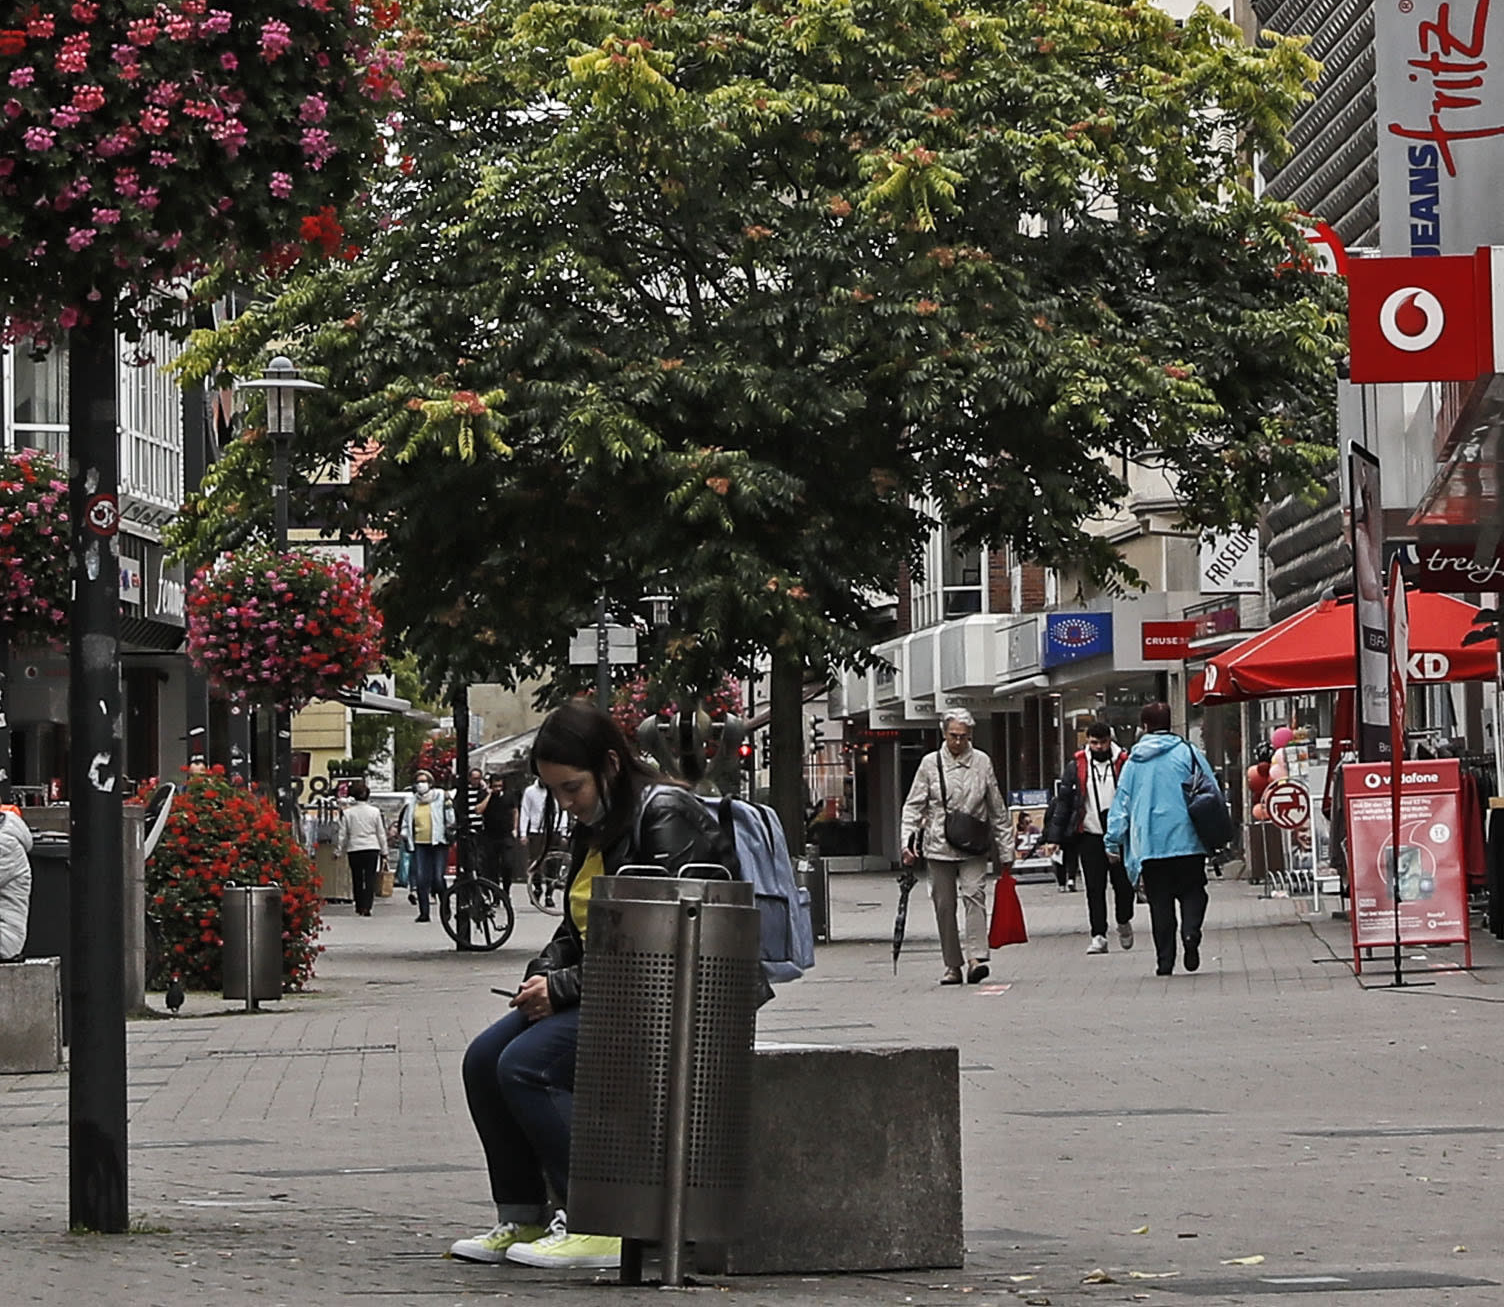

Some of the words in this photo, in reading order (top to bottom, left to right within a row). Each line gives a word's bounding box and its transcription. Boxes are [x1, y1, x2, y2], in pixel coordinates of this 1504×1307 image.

[1406, 143, 1440, 257] JEANS
[1204, 530, 1257, 587] FRISEUR
[1145, 636, 1178, 646] CRUSE
[1383, 772, 1439, 784] vdafone
